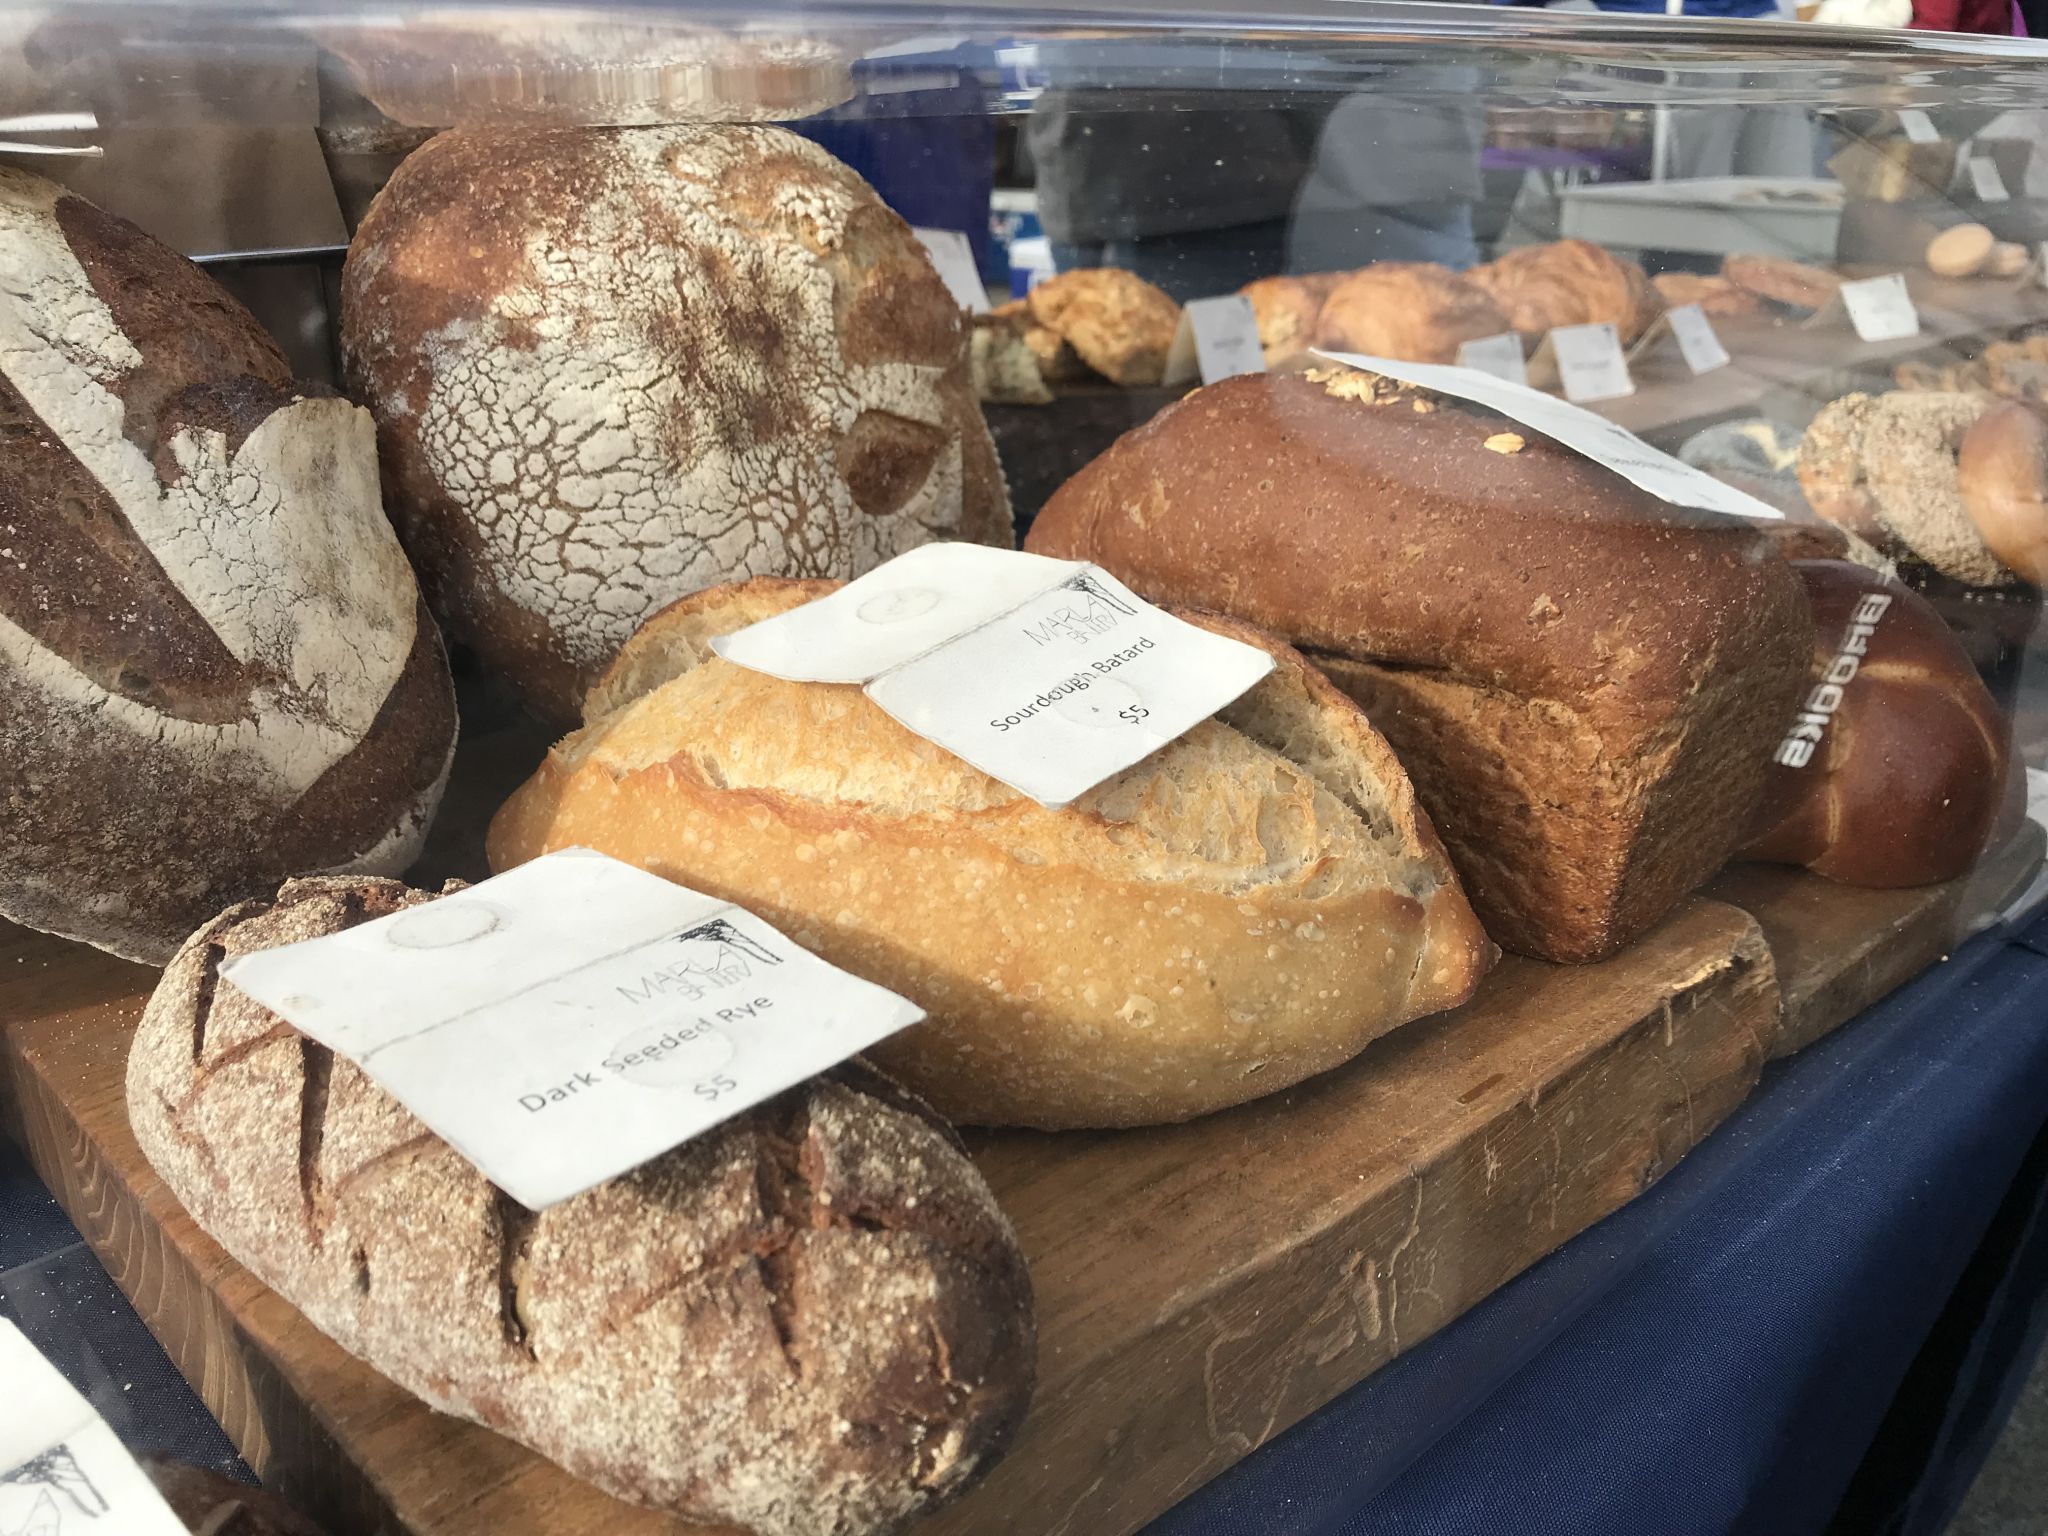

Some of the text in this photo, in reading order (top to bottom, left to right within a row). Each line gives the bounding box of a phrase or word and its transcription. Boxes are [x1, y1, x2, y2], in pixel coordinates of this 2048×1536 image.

[990, 636, 1157, 732] Sourdough Batard
[1118, 703, 1150, 725] $5
[518, 996, 774, 1113] Dark Seeded Rye
[693, 1073, 738, 1101] $5
